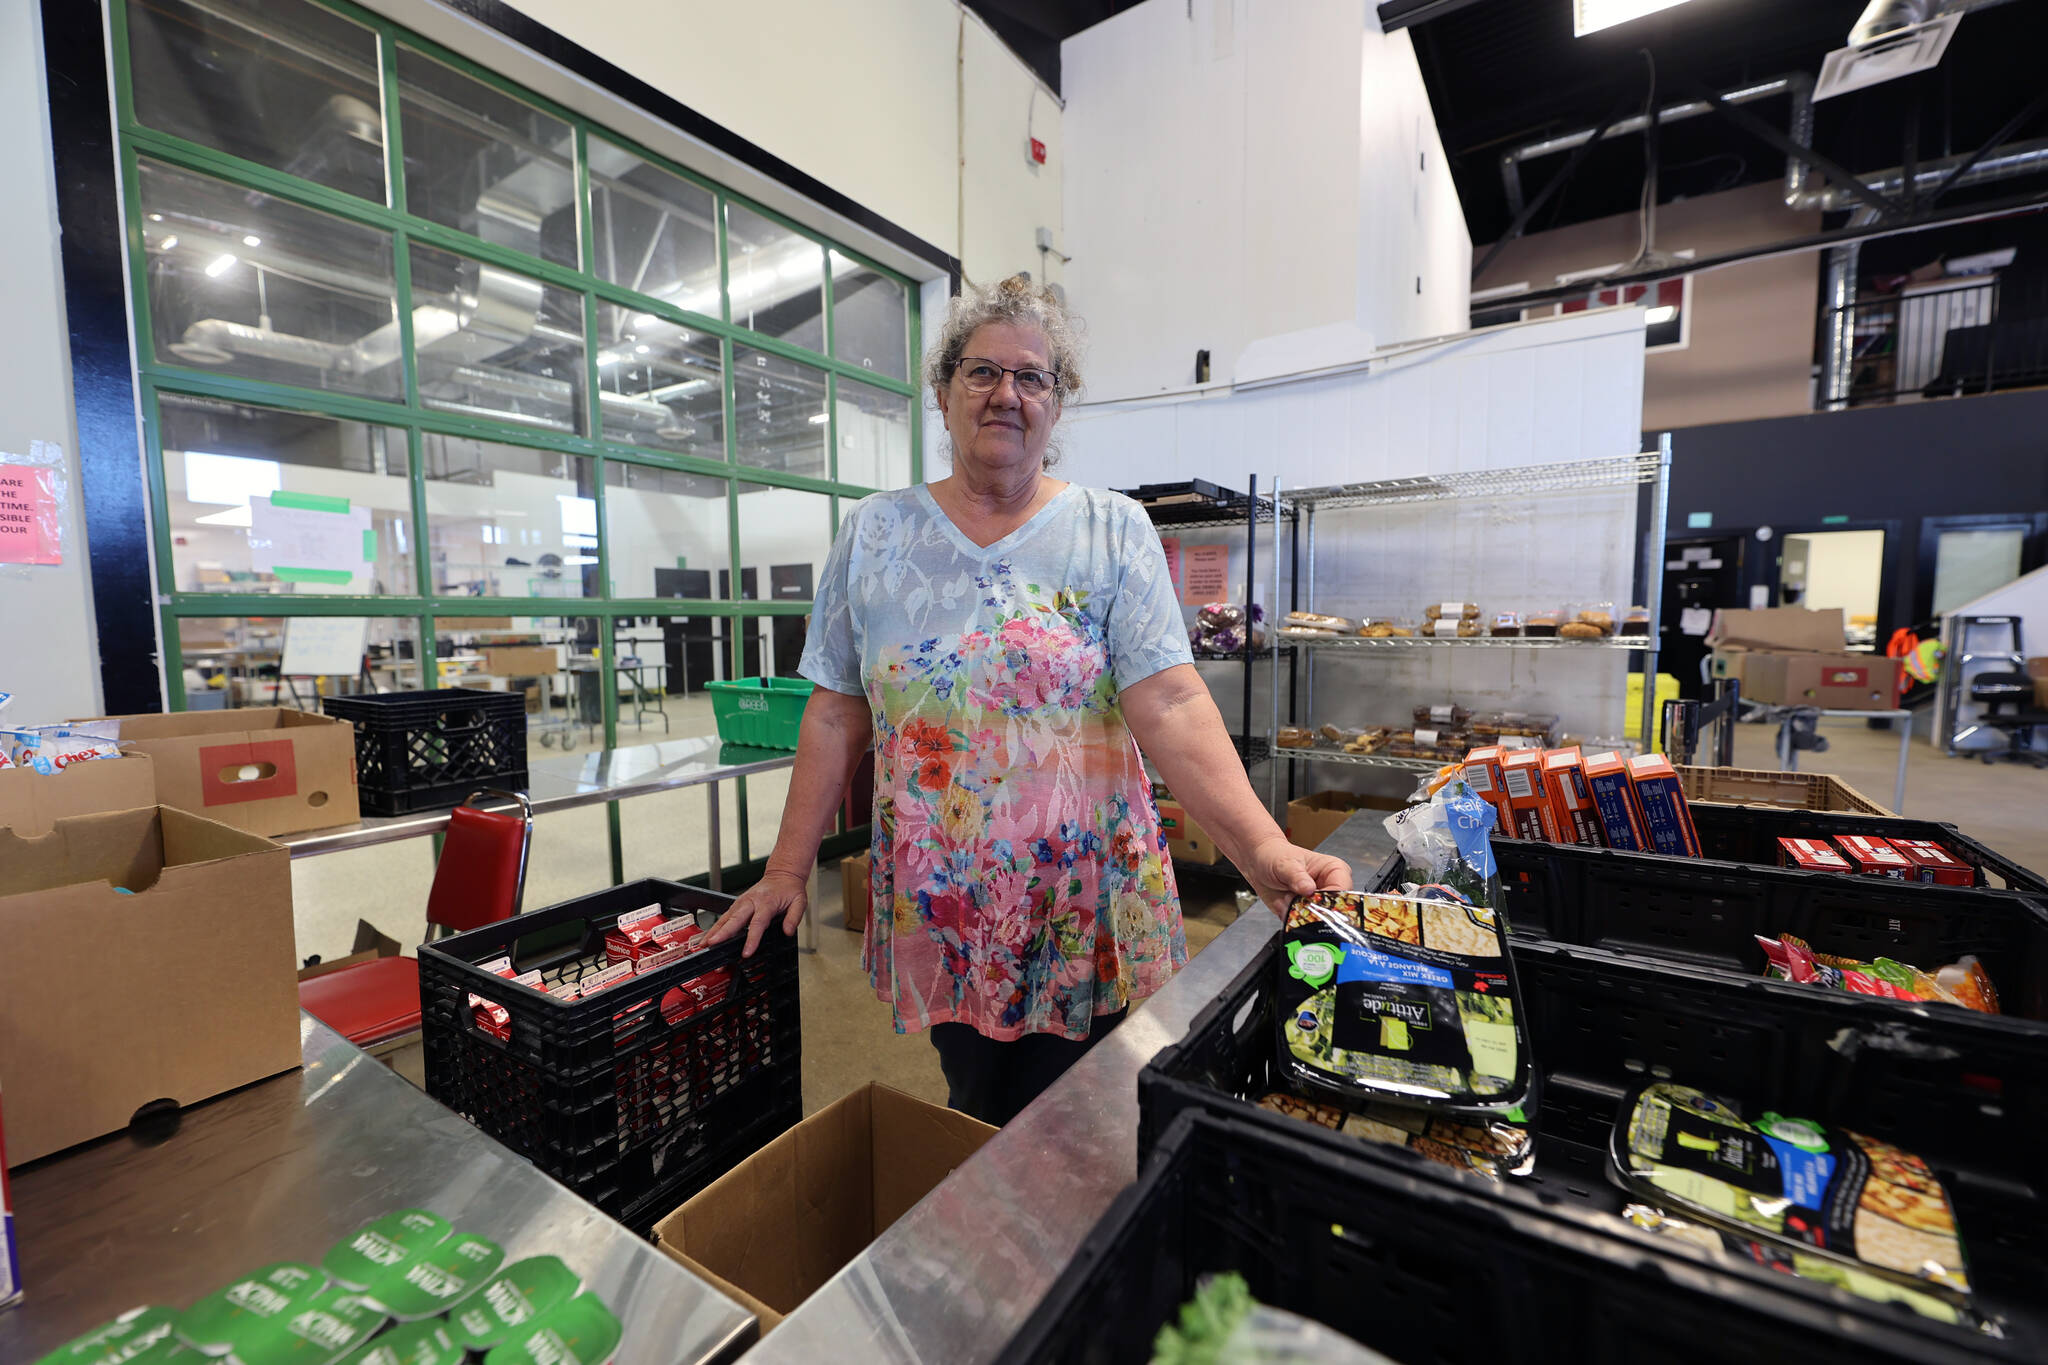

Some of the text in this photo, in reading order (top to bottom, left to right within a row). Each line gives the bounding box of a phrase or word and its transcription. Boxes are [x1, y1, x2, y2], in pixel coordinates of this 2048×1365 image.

[0, 479, 23, 487] ARE
[0, 490, 17, 498] HE
[0, 502, 34, 511] TIME.
[55, 748, 101, 769] Chex
[1457, 815, 1482, 829] Ch
[1351, 949, 1390, 962] GRECQUE
[1368, 958, 1379, 967] LA
[1402, 970, 1419, 979] MIX
[1421, 972, 1448, 983] GREEK
[1362, 998, 1425, 1020] Attitude
